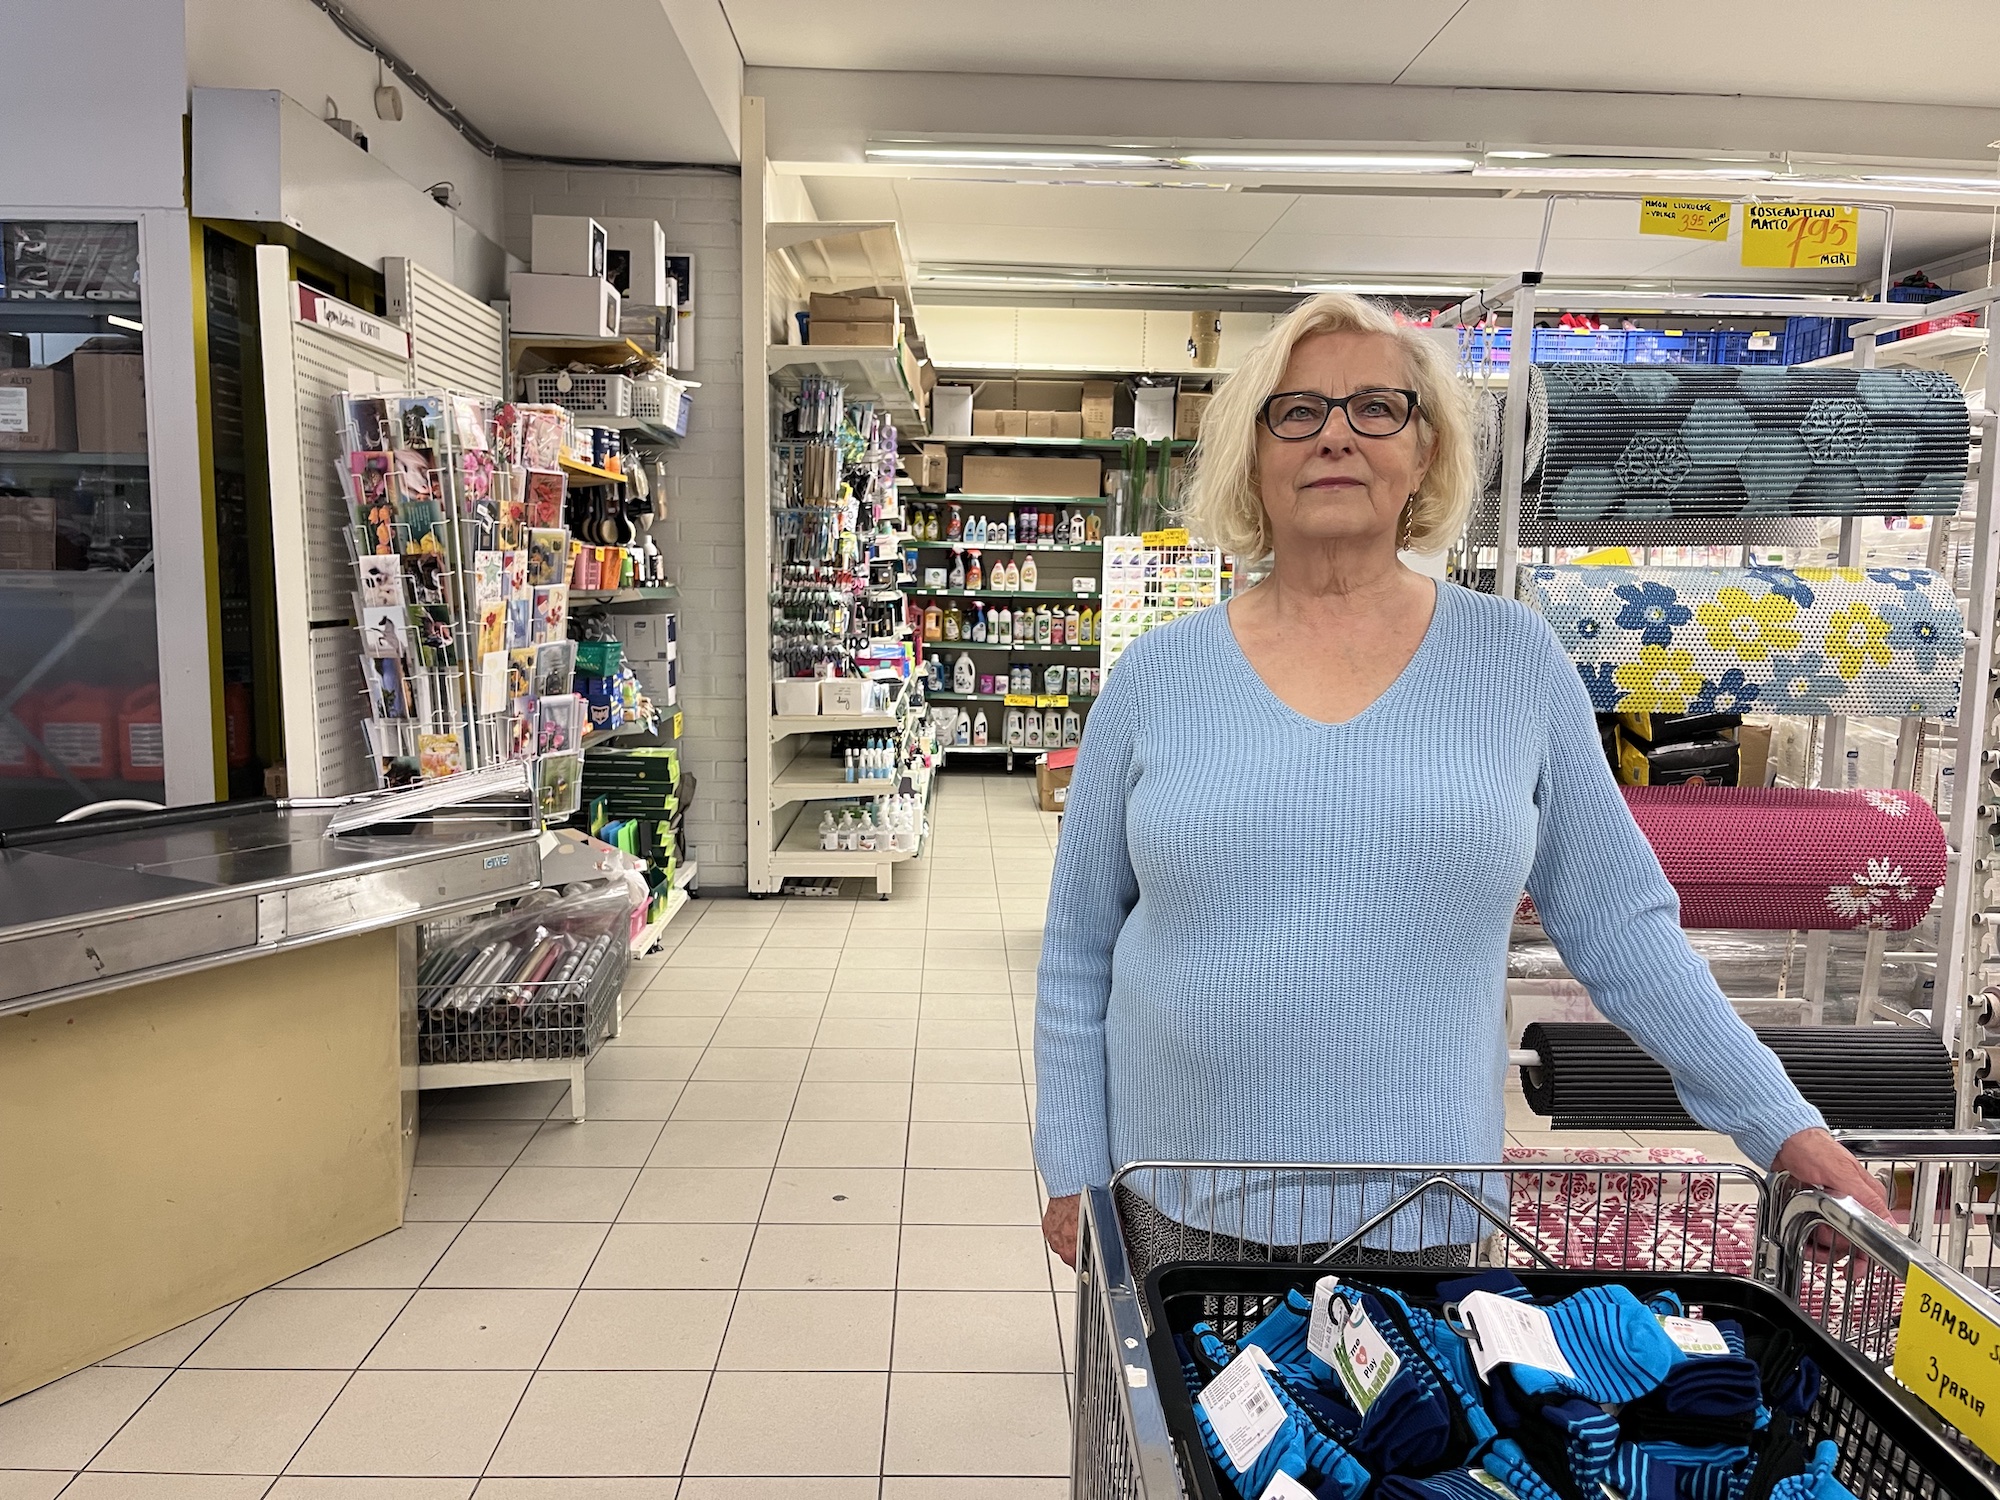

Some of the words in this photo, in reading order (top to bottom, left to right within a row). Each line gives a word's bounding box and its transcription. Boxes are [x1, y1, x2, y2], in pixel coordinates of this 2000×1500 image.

[1750, 218, 1788, 230] MATTO
[1820, 252, 1850, 266] METRI
[11, 289, 138, 300] NYLON
[10, 377, 33, 385] ALTO
[1918, 1293, 1980, 1347] BAMBU
[1350, 1338, 1361, 1357] me
[1366, 1351, 1395, 1402] AMBOO
[1926, 1356, 1939, 1382] 3
